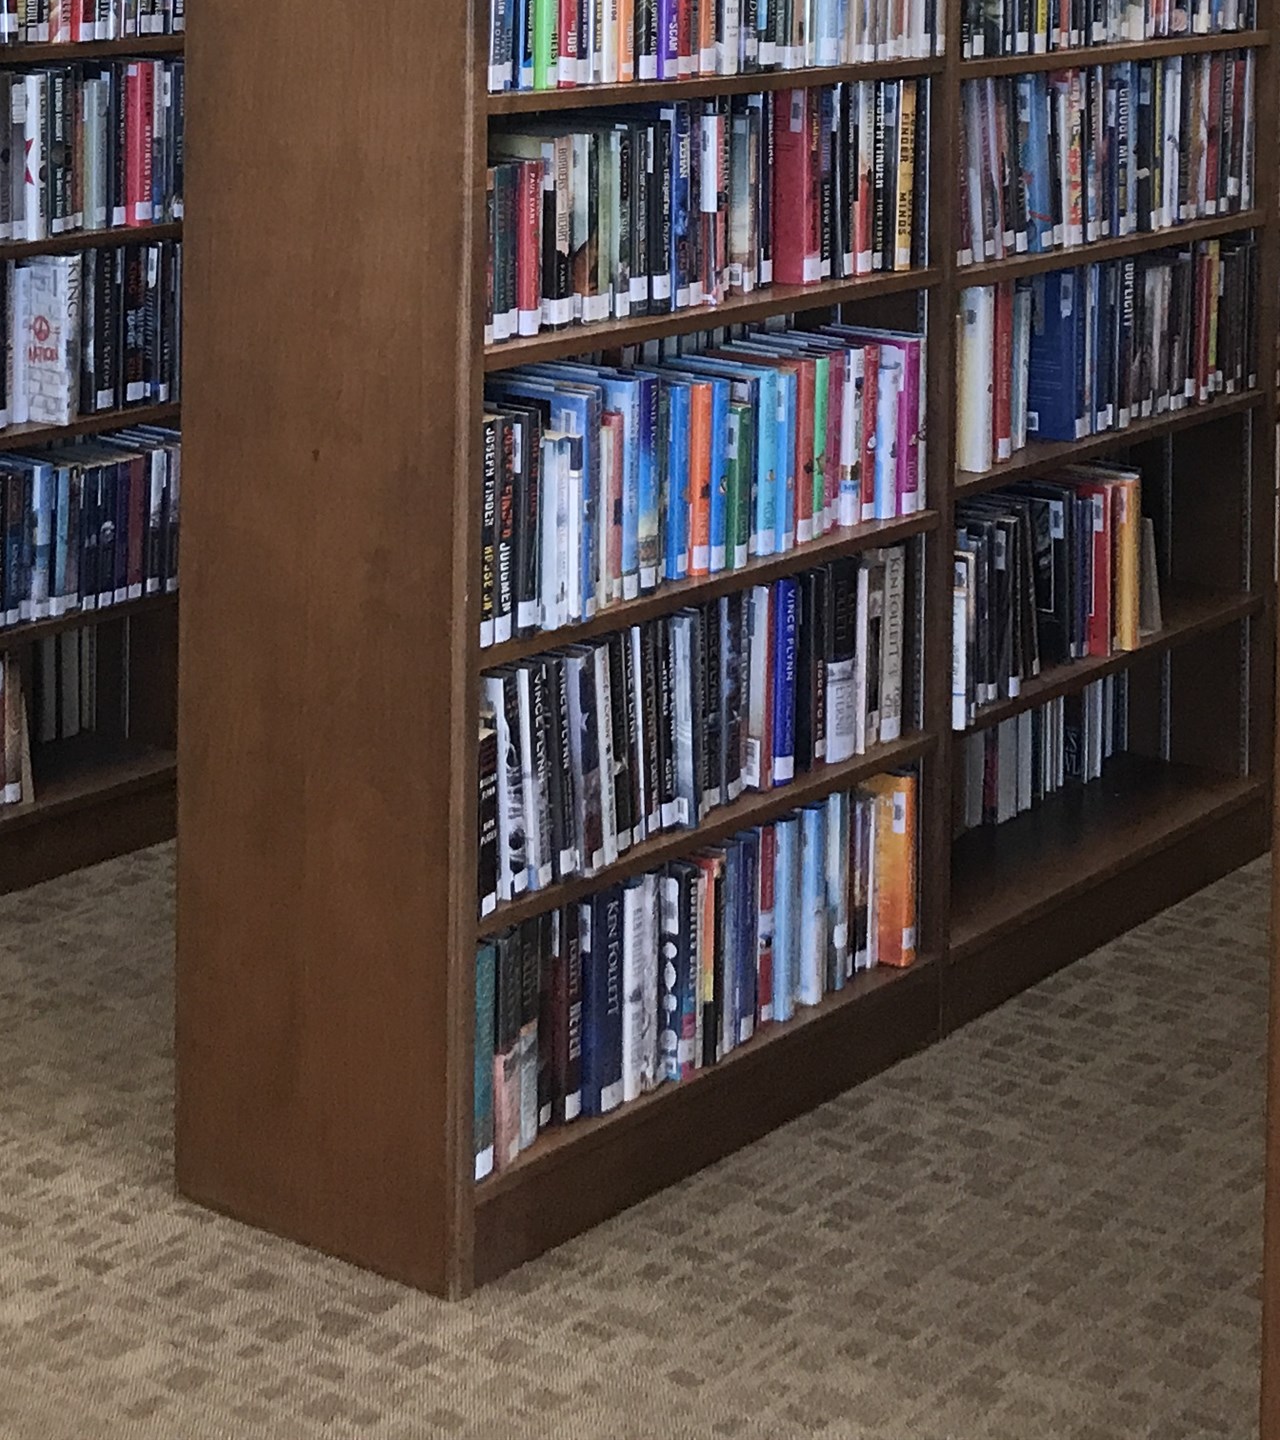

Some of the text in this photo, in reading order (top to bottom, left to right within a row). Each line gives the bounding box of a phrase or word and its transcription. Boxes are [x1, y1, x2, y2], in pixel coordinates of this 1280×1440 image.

[568, 32, 577, 52] JOB
[669, 23, 677, 51] SCAM
[900, 113, 908, 162] FINDER
[1123, 263, 1134, 327] DUPLICITY
[484, 428, 494, 610] JOSEPH FINDER ON
[888, 558, 900, 657] KEN FOLLETT
[533, 673, 545, 783] VINCE FLYNN
[562, 720, 570, 769] FLYNN
[607, 901, 620, 1016] KEN FOLLETT
